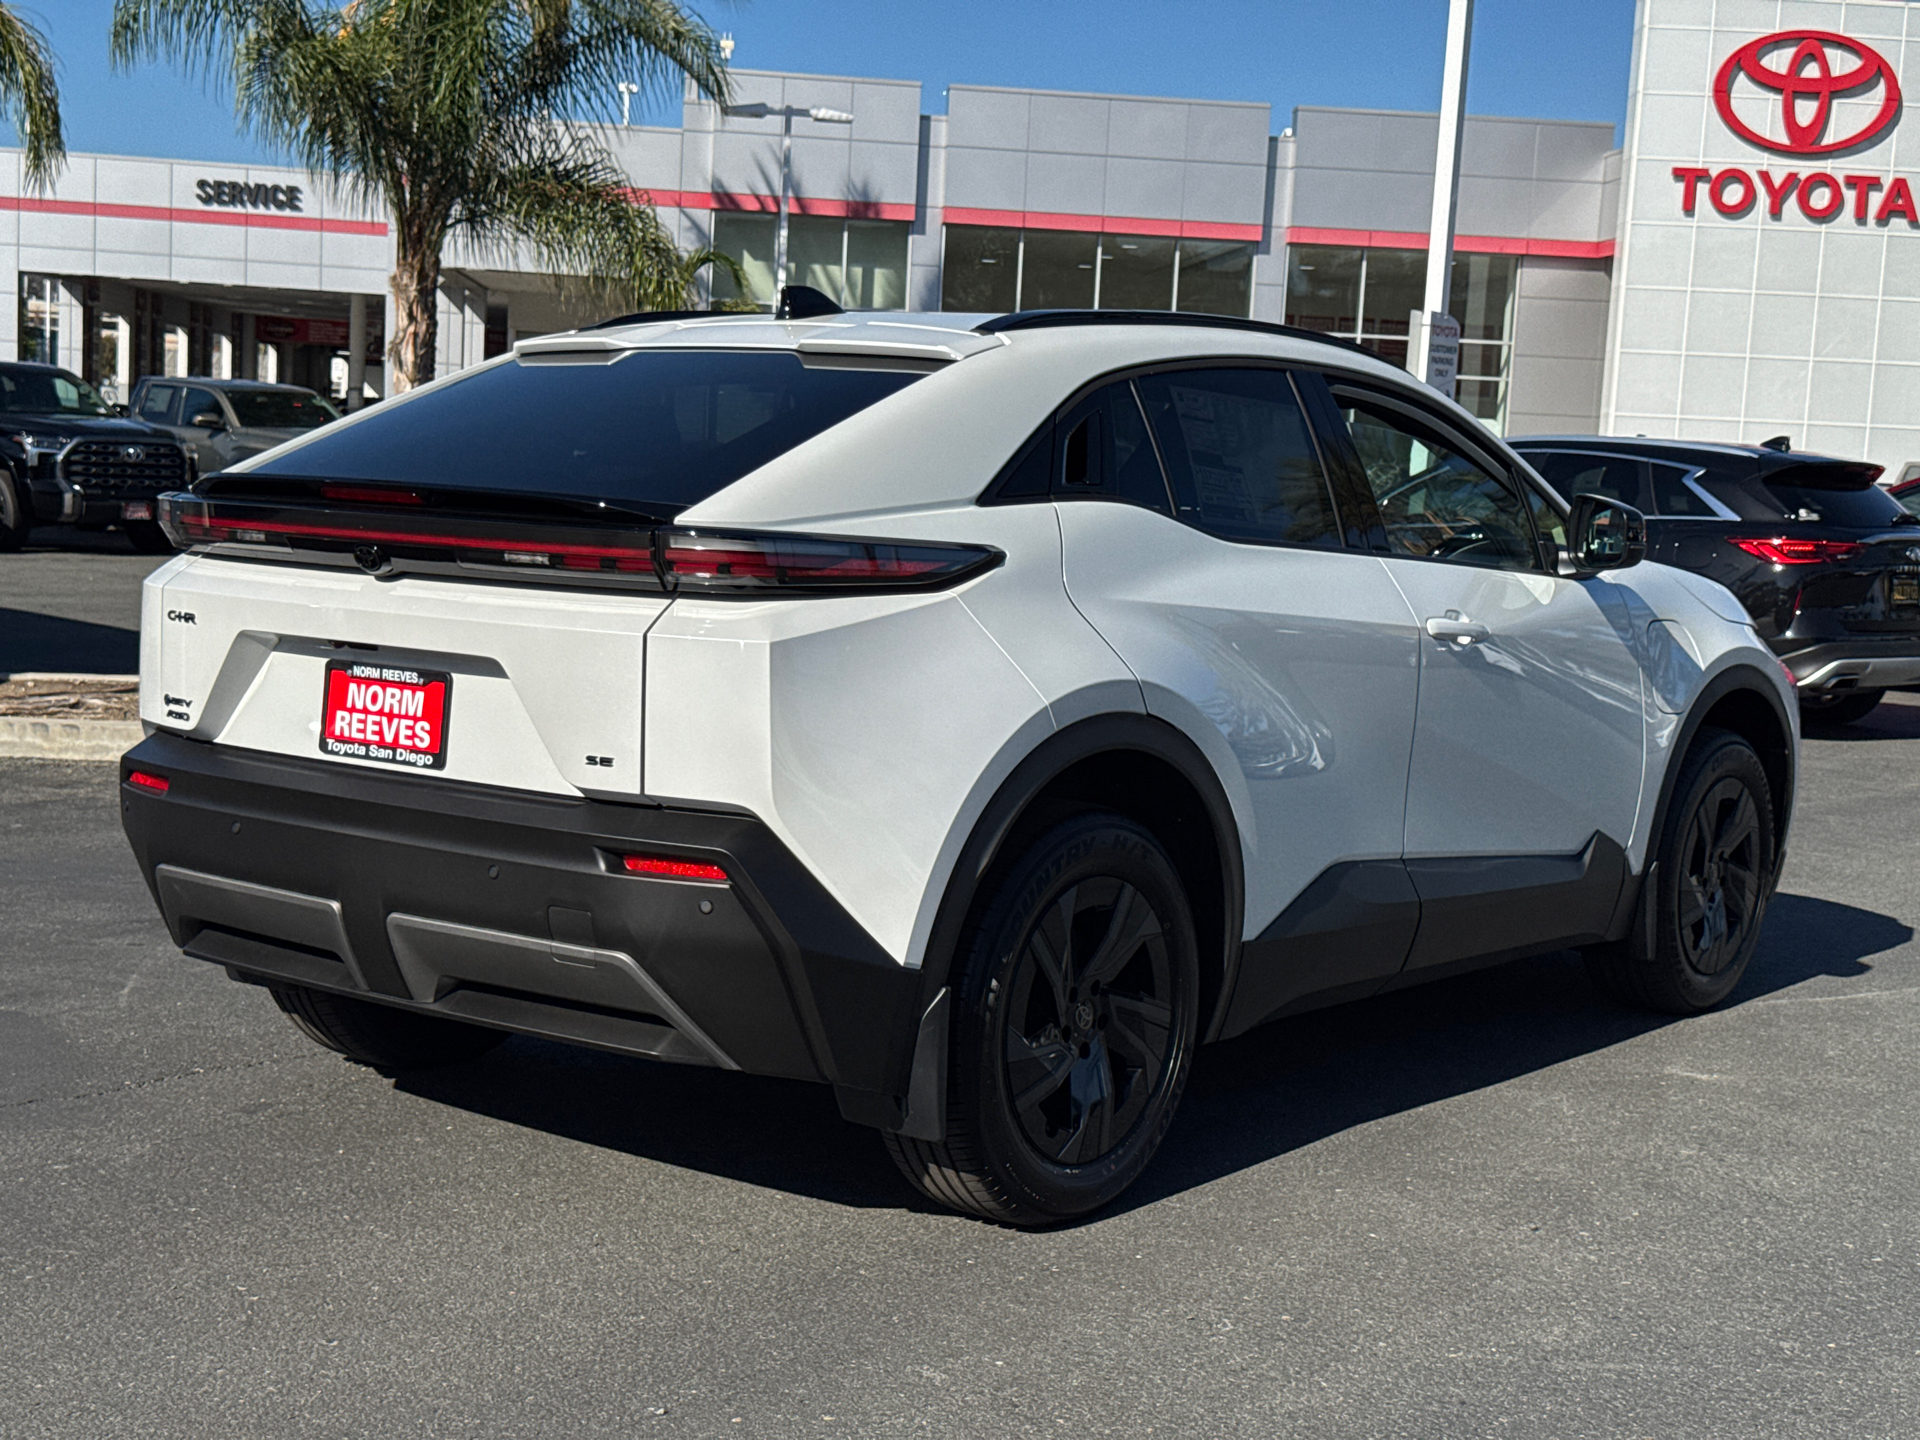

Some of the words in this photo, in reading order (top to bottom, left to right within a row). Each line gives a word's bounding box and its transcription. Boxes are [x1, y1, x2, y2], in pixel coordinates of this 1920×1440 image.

[196, 179, 303, 211] SERVICE
[1671, 167, 1920, 224] TOYOTA
[1432, 324, 1458, 338] TOYOTA
[1430, 344, 1457, 354] CUSTOMER
[1431, 355, 1454, 366] PARKING
[1434, 367, 1449, 378] ONLY
[353, 665, 380, 679] NORM
[382, 668, 418, 683] REEVES
[346, 682, 425, 717] NORM
[334, 710, 431, 748] REEVES
[326, 738, 366, 755] Toyota
[369, 745, 393, 759] San
[396, 748, 433, 766] Diego
[585, 755, 615, 768] SE
